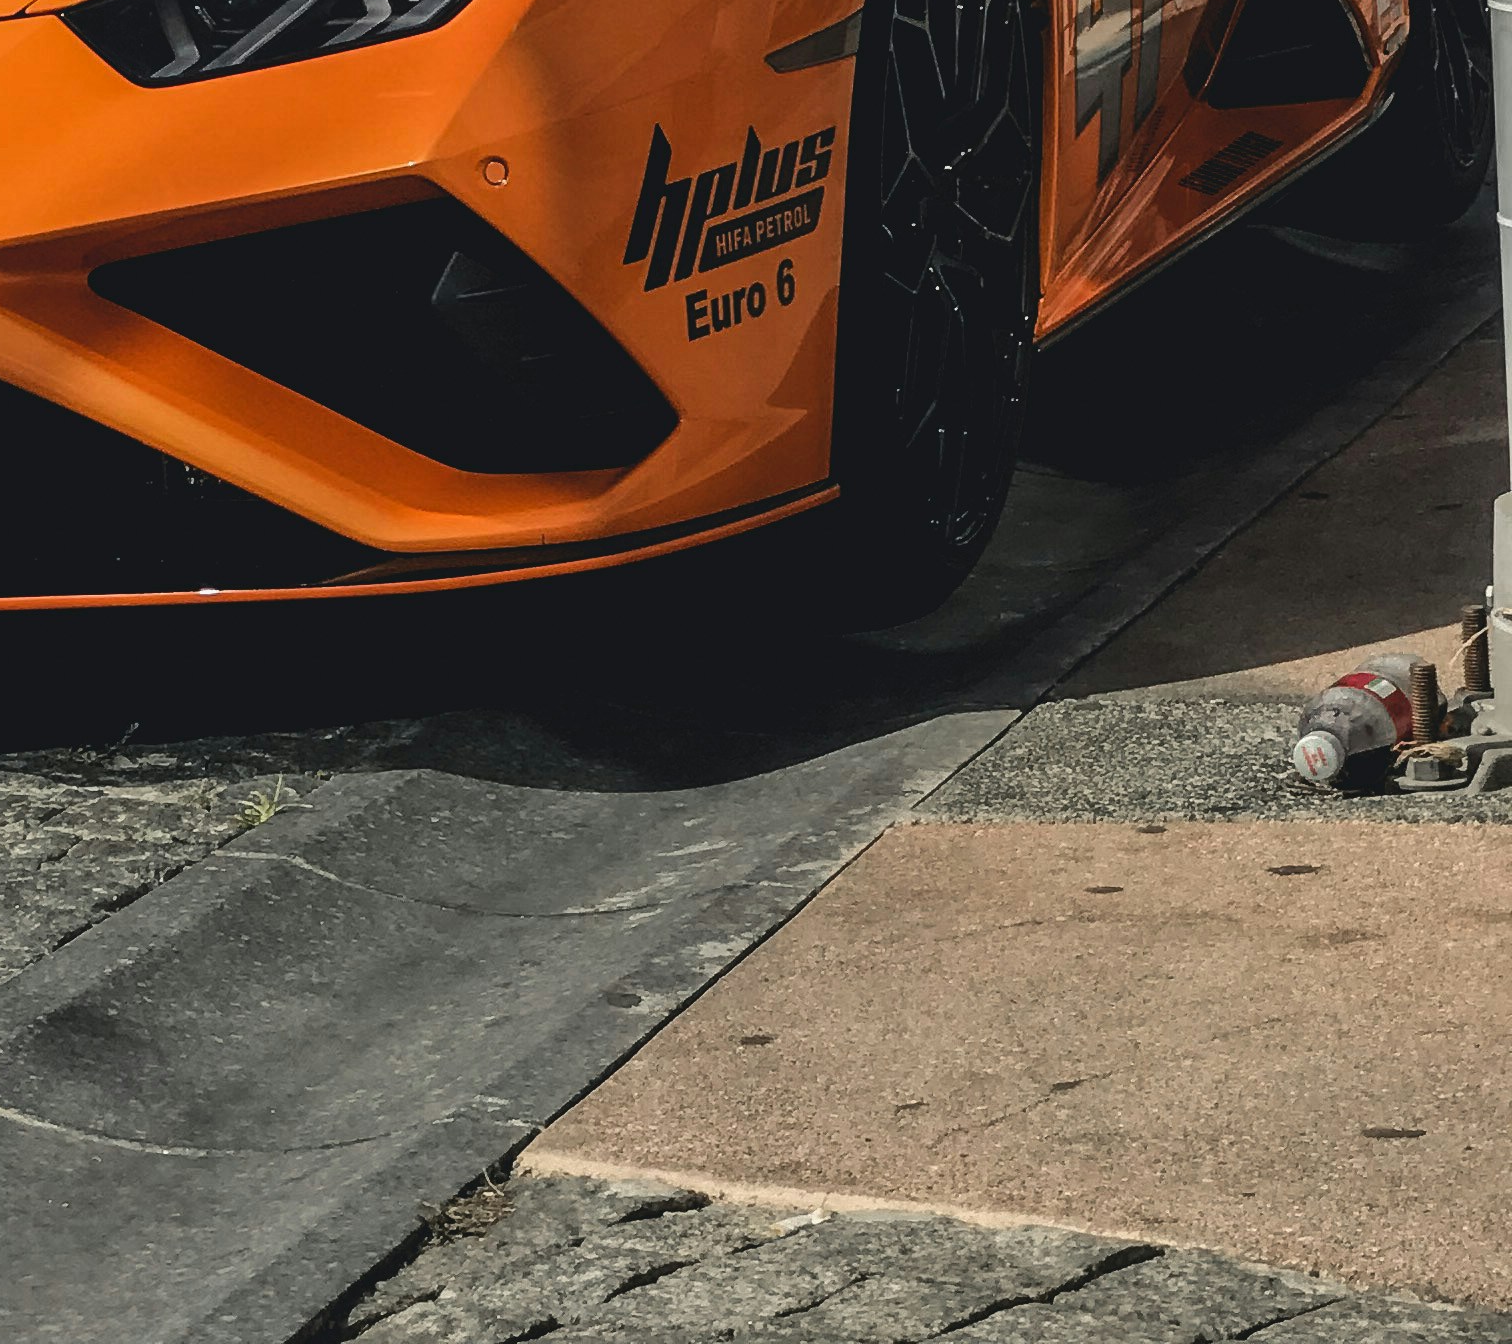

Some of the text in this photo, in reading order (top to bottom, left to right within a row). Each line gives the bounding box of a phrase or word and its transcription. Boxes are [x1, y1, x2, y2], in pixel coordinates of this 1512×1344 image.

[622, 122, 837, 293] hplus
[715, 203, 812, 258] HIFA PETROL
[685, 258, 796, 343] Euro 6
